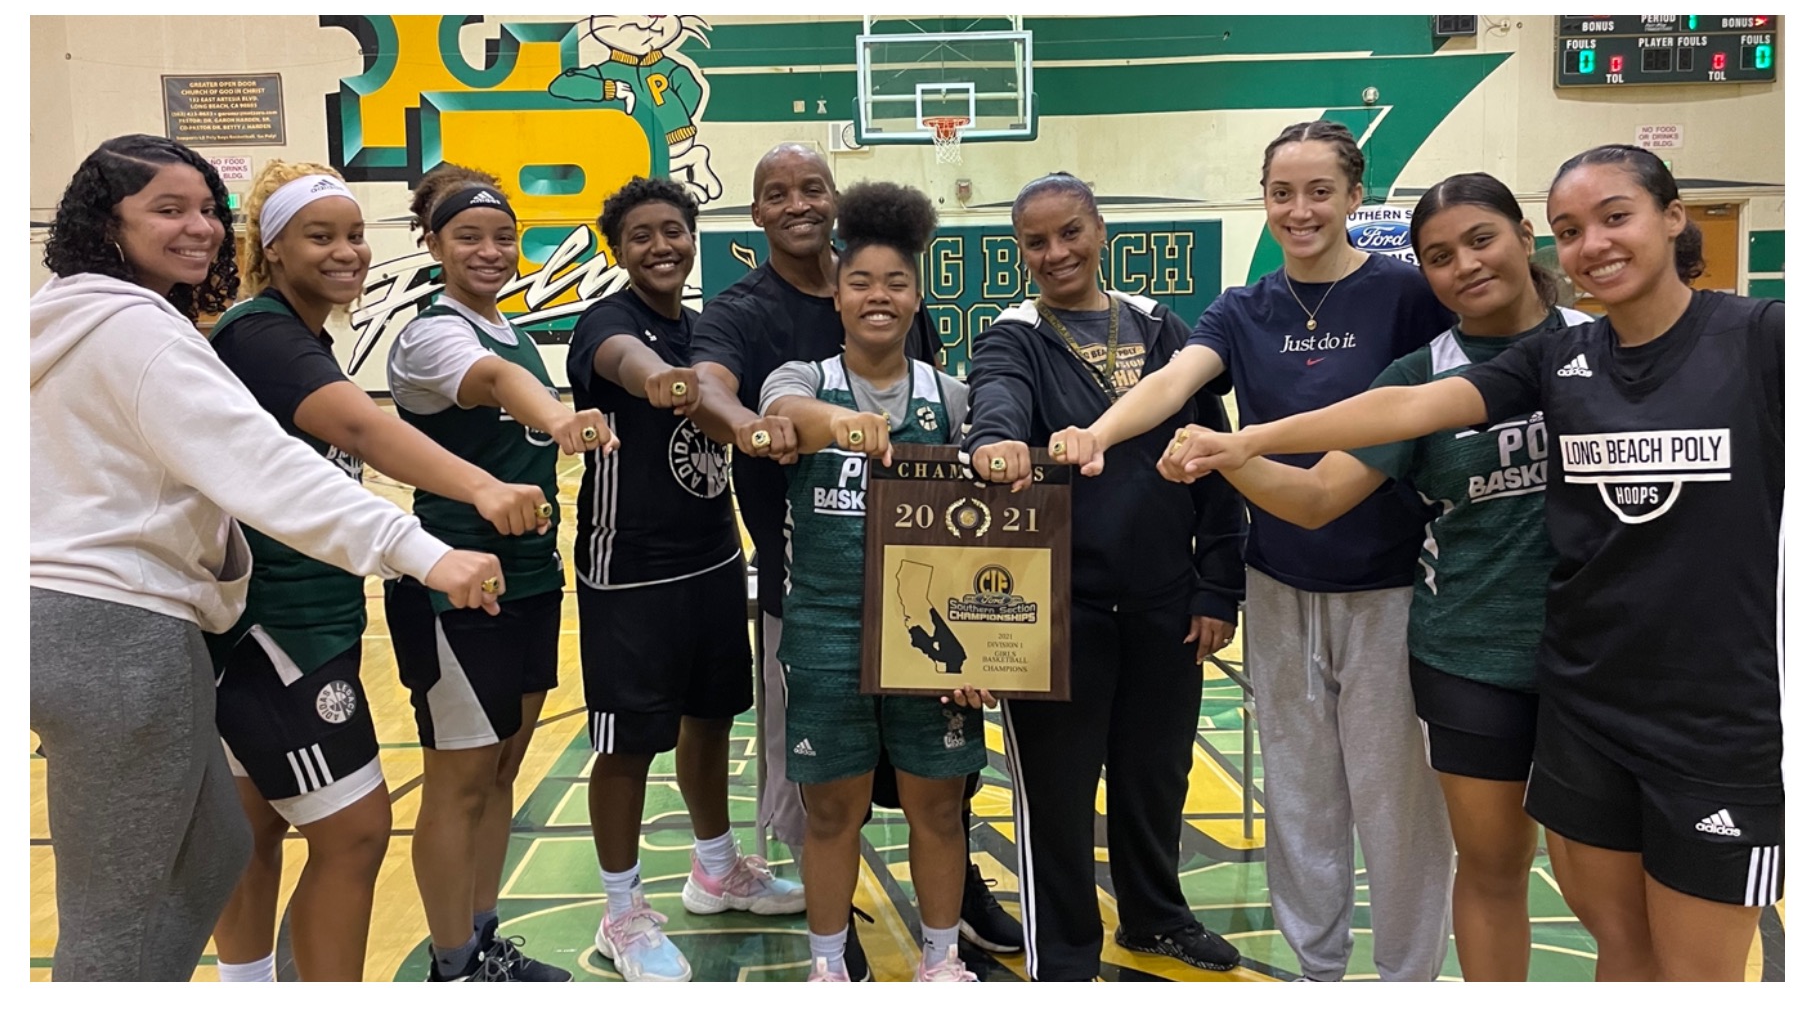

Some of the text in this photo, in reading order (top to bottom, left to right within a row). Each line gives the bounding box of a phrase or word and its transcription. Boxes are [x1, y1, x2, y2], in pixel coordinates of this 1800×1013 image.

[1582, 15, 1754, 32] BONUS PERIOD BONUS
[1566, 35, 1771, 50] FOULS PLAYER FOULS FOULS
[1606, 74, 1625, 84] TOL
[1708, 71, 1727, 81] TOL
[646, 72, 668, 107] P
[1348, 210, 1401, 221] UTHERN
[1357, 226, 1408, 247] Ford
[1280, 332, 1356, 353] Just do it.
[1557, 368, 1593, 378] adidas
[1497, 422, 1548, 468] PO
[1564, 436, 1722, 465] LONG BEACH POLY
[814, 487, 866, 510] BASK
[1615, 486, 1659, 505] HOOPS
[895, 503, 1040, 532] 20 21
[978, 569, 1009, 594] CIF
[949, 599, 1036, 614] Southern Section
[980, 594, 1006, 604] Ford
[949, 610, 1036, 622] CHAMPIONSHIPS
[982, 656, 1028, 664] BASKETBALL
[982, 665, 1028, 673] CHAMPIONS
[1694, 822, 1742, 837] adidas
